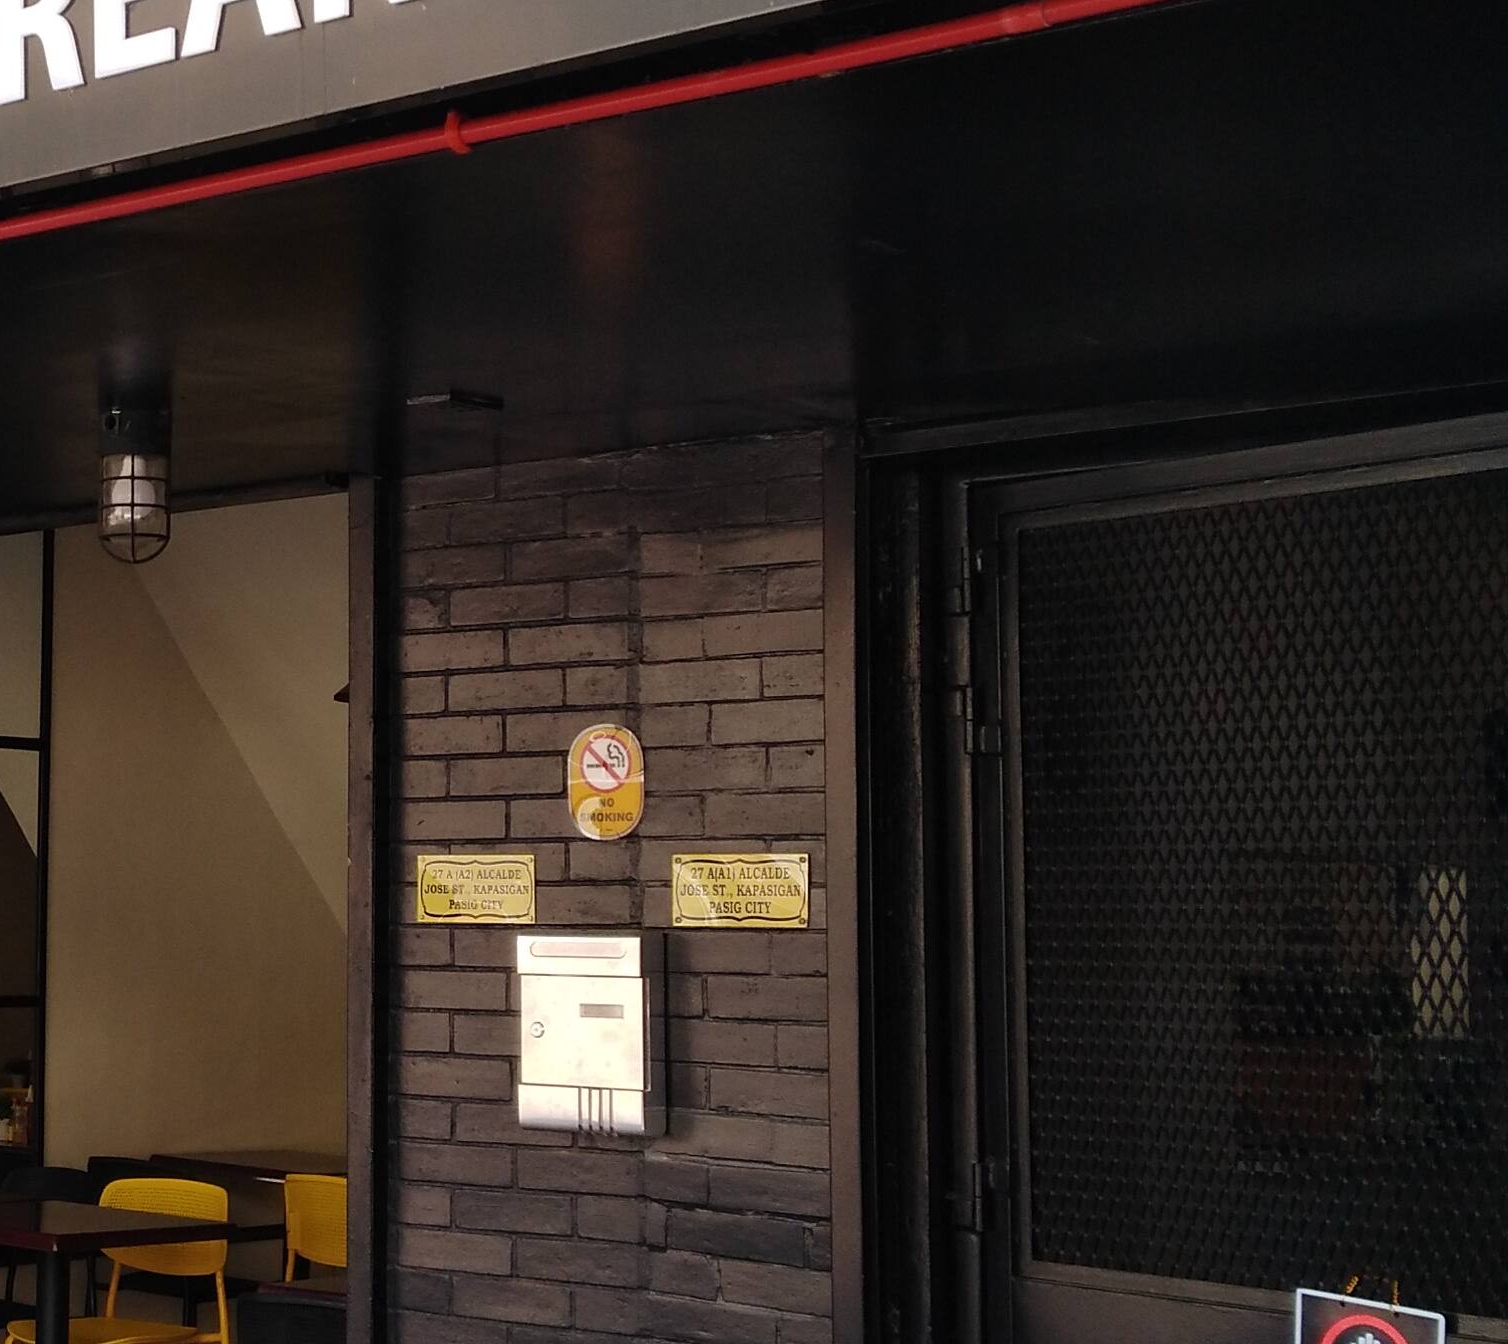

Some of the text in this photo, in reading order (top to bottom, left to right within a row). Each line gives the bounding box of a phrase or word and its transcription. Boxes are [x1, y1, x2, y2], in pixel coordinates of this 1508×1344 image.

[599, 797, 616, 808] NO
[580, 811, 634, 822] SMOKING
[432, 869, 444, 880] 27
[476, 869, 522, 880] ALCALDE
[691, 867, 704, 880] 27
[739, 867, 791, 880] ALCALDE
[424, 885, 450, 895] JOSE
[473, 884, 530, 895] KAPASIGAN
[680, 884, 709, 896] JOSE
[737, 884, 801, 896] KAPASIGAN
[449, 899, 505, 910] PASIG CITY
[709, 901, 772, 914] PASIG CITY
